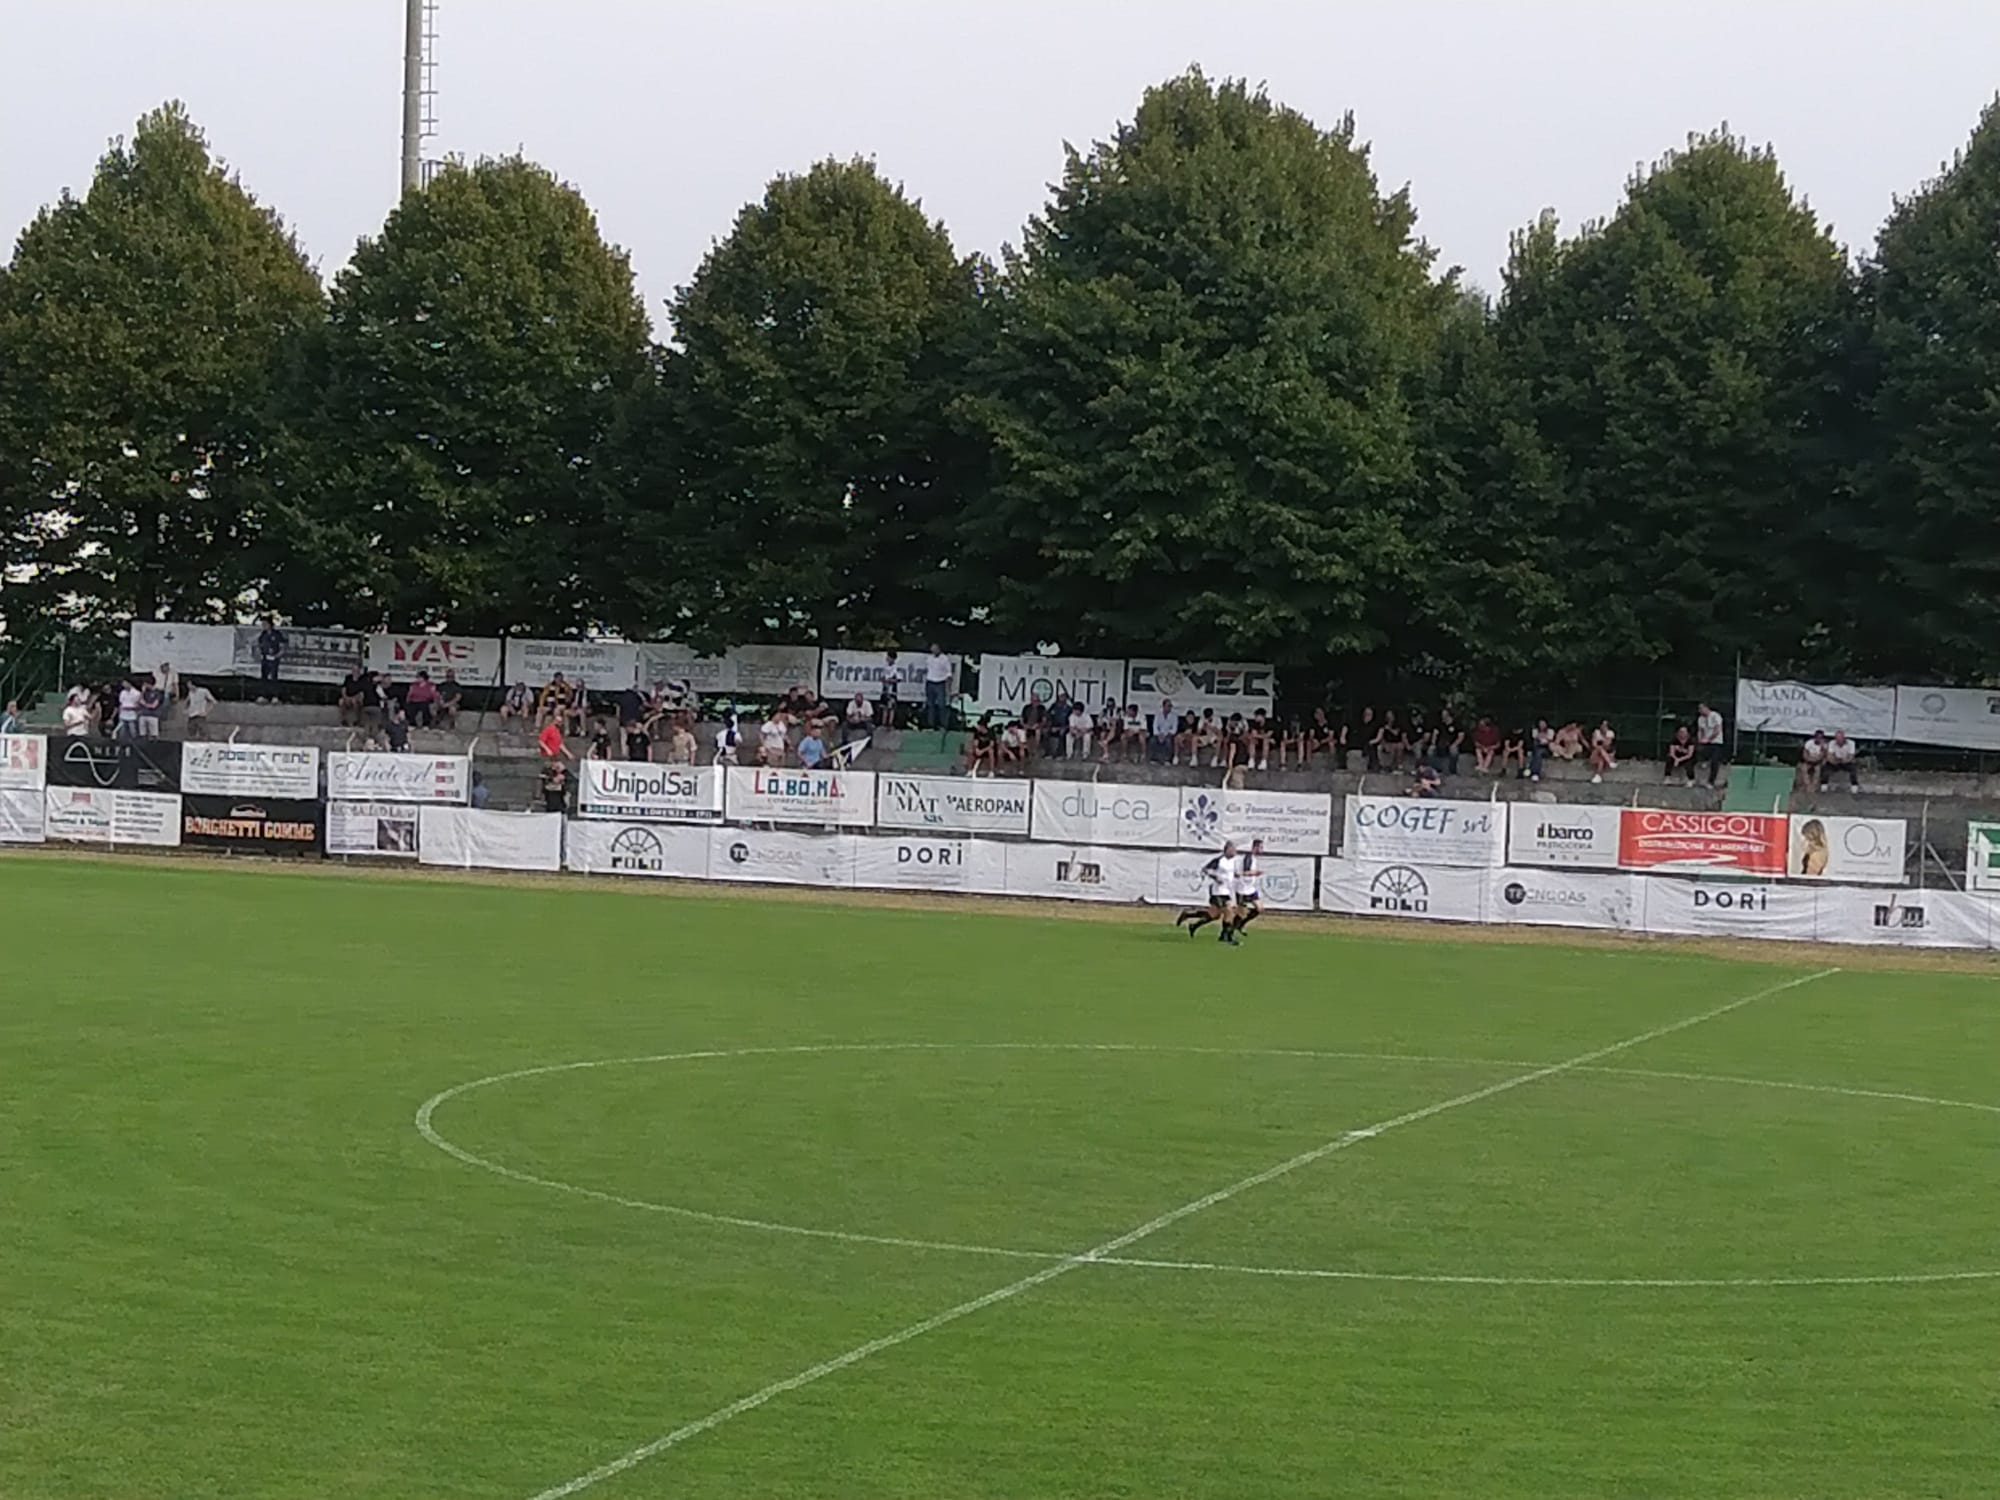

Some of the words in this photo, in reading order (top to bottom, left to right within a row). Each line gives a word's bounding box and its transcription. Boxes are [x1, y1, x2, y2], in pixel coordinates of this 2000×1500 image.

[999, 676, 1107, 706] MONTI
[601, 769, 698, 802] UnipolSai
[887, 781, 922, 796] INN
[896, 796, 939, 813] MAT
[955, 797, 1025, 814] AEROPAN
[1062, 788, 1150, 820] du-ca
[184, 816, 261, 838] BORGHETTI
[263, 821, 316, 841] GOMME
[1356, 803, 1457, 834] COGEF
[1642, 813, 1766, 836] CASSIGOLI
[1547, 823, 1594, 840] barco
[1370, 896, 1428, 912] POLO
